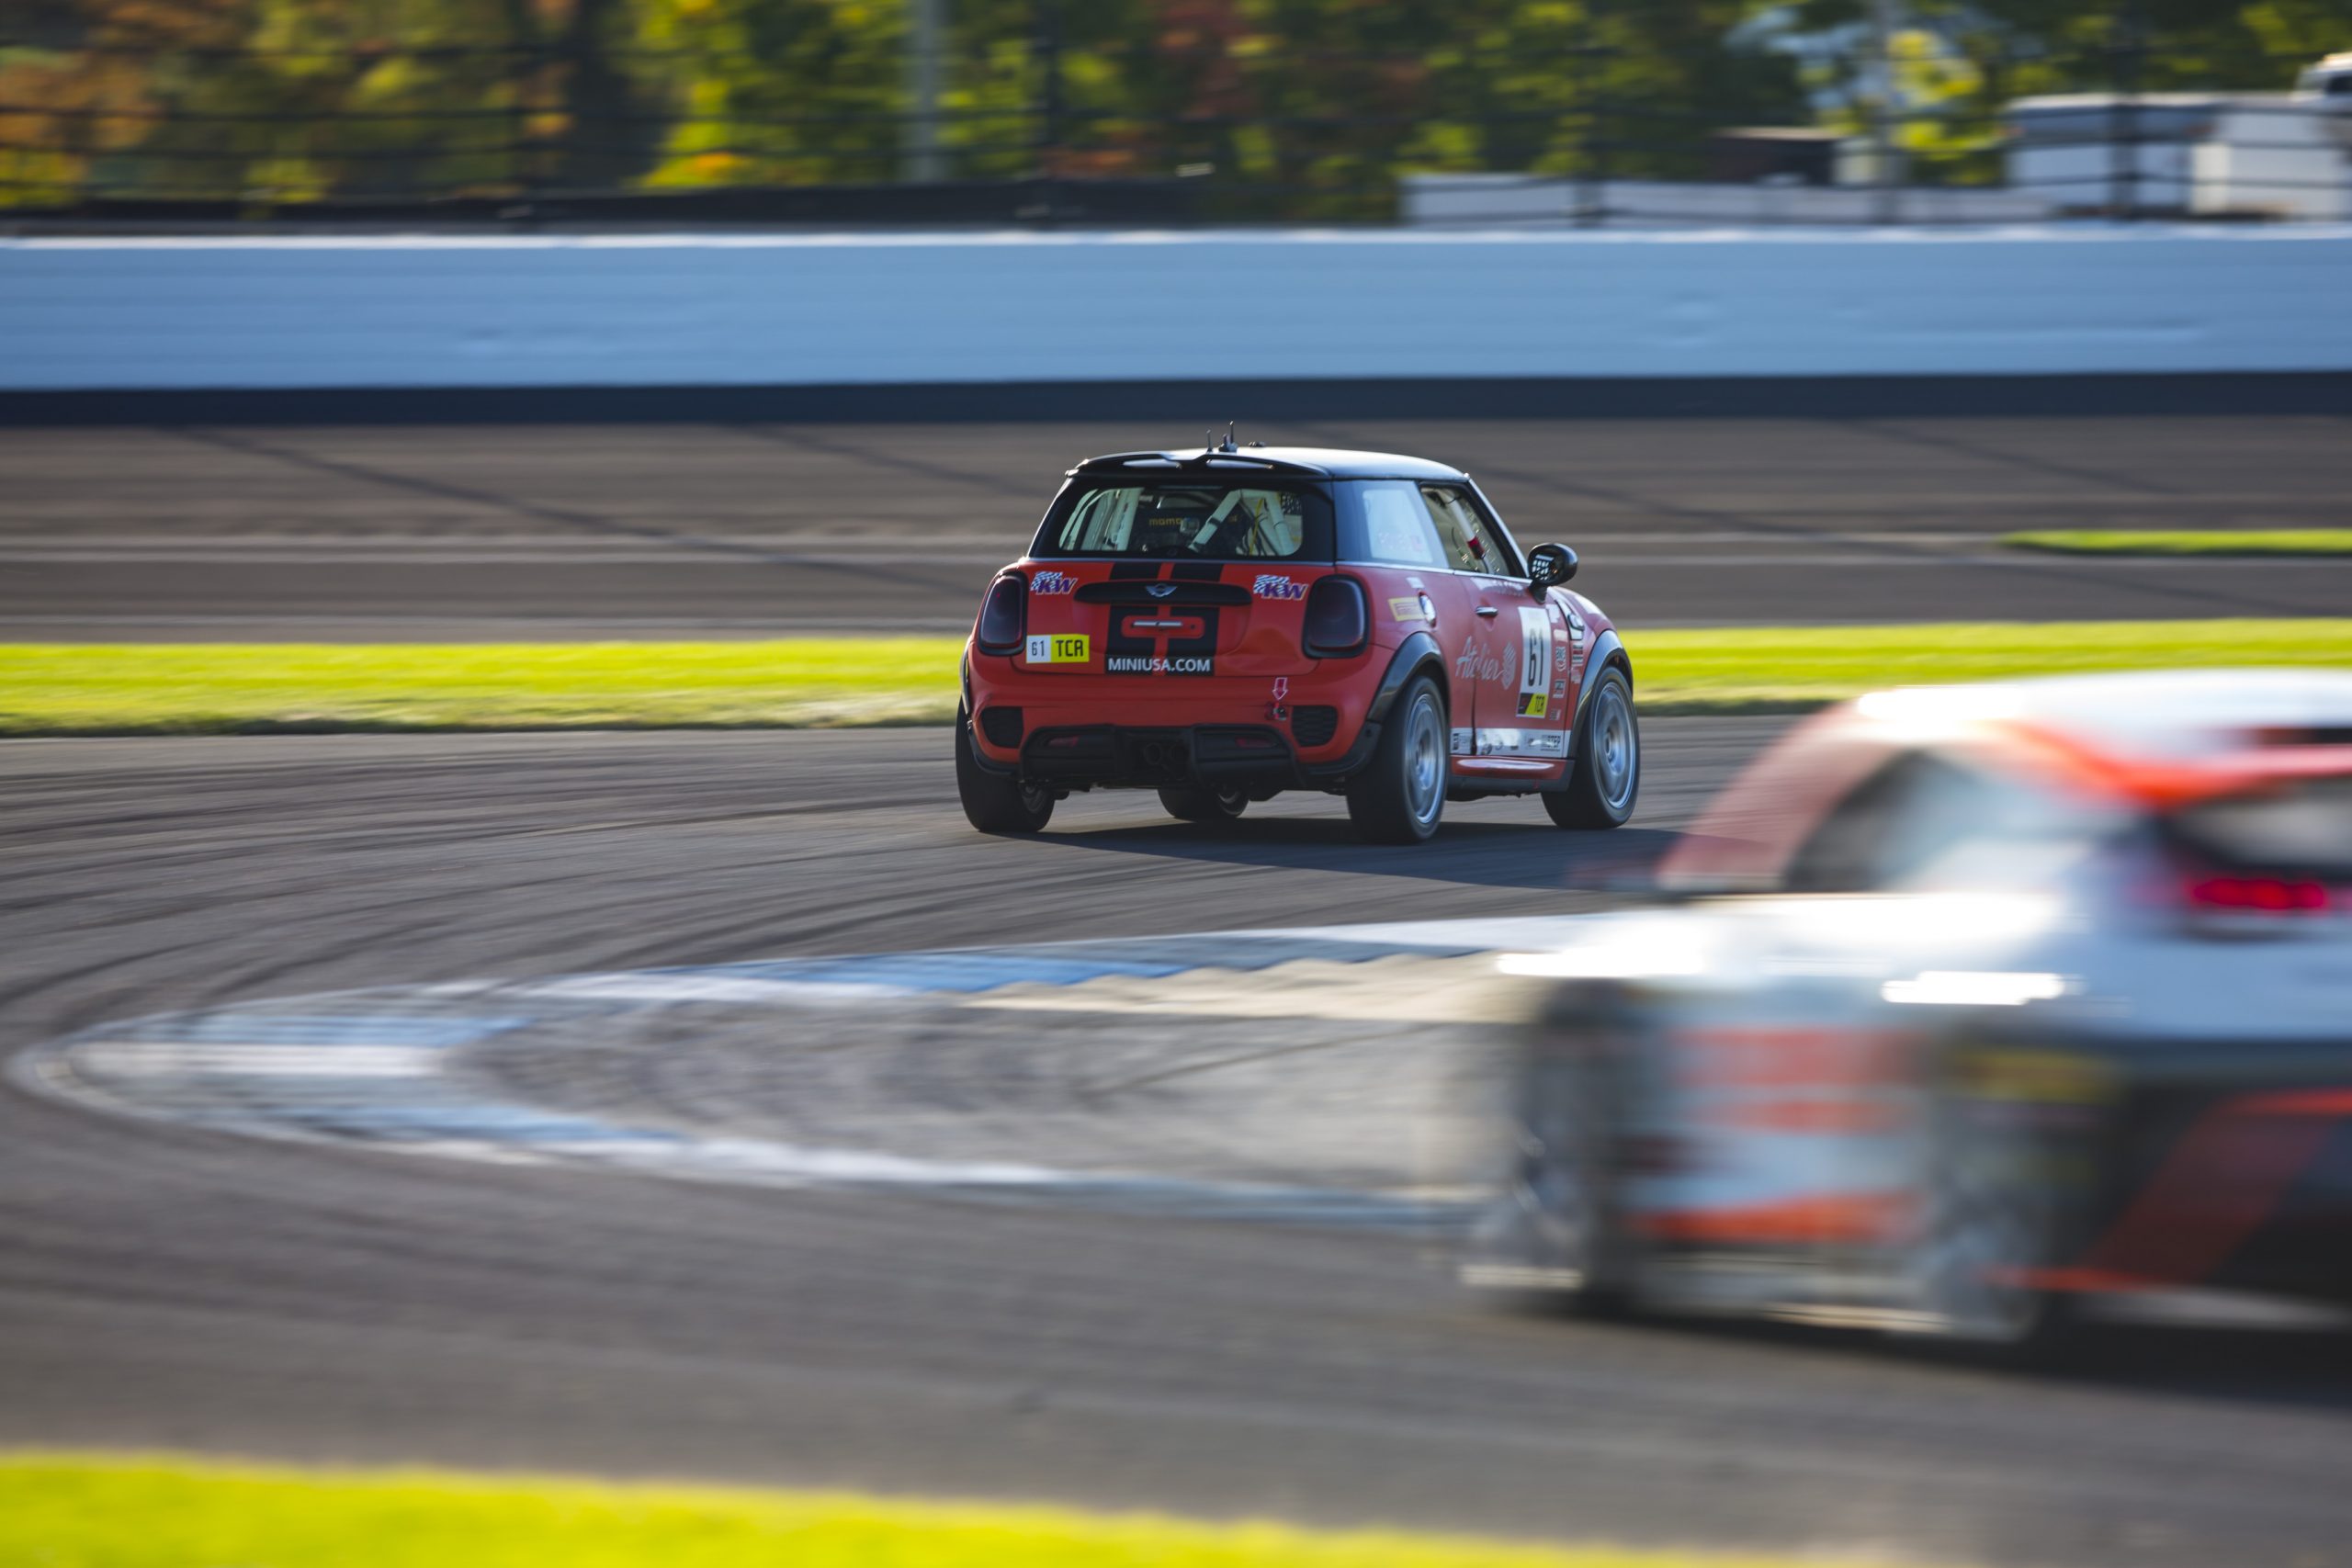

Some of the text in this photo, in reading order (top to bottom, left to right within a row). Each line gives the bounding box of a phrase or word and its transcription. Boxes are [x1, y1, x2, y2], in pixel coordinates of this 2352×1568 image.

[1035, 578, 1079, 594] KW
[1261, 582, 1309, 600] KW
[1031, 639, 1084, 658] 61 TCR
[1528, 628, 1544, 687] 61
[1108, 658, 1211, 672] MINIUSA.COM
